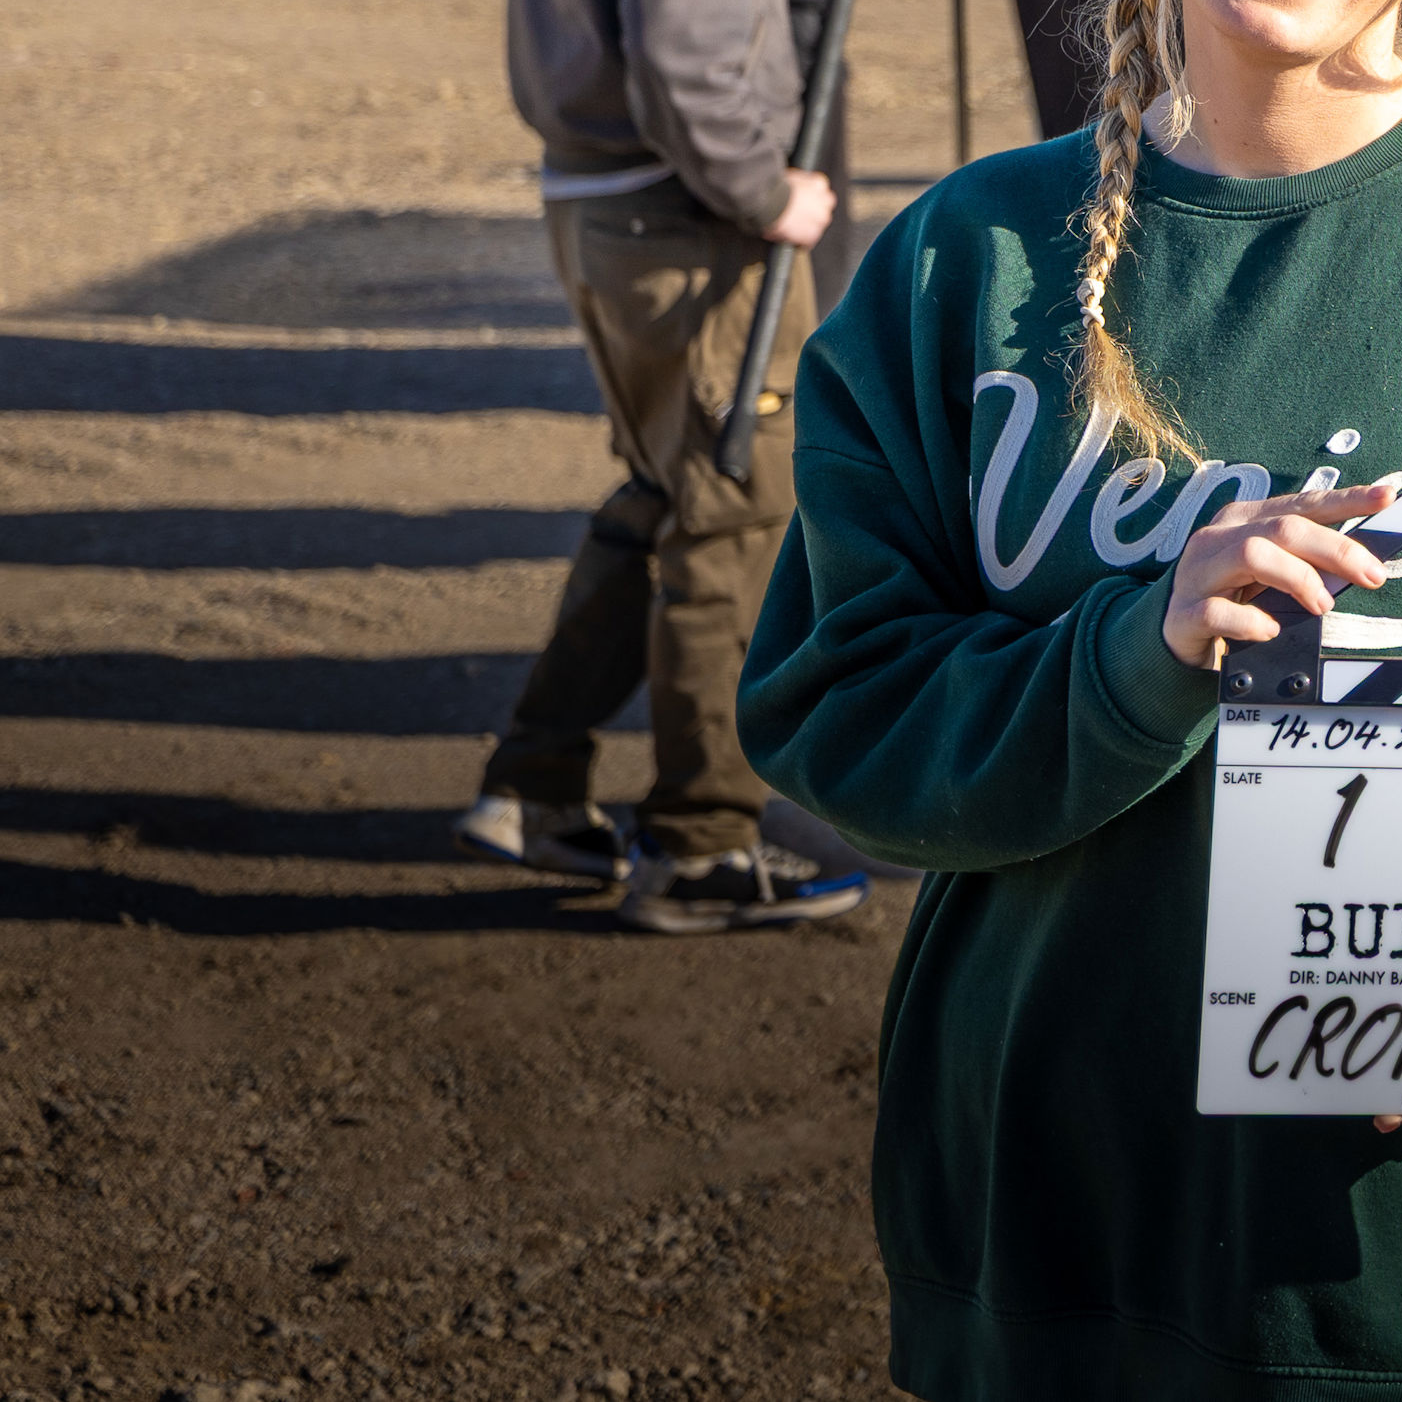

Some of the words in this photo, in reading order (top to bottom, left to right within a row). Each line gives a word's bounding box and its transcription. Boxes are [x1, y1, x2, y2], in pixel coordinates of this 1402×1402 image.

[1225, 708, 1261, 722] DATE
[1222, 771, 1263, 785] SLATE
[1322, 772, 1369, 869] 1
[1289, 970, 1321, 986] DIR:
[1325, 970, 1386, 986] DANNY
[1209, 991, 1257, 1005] SCENE
